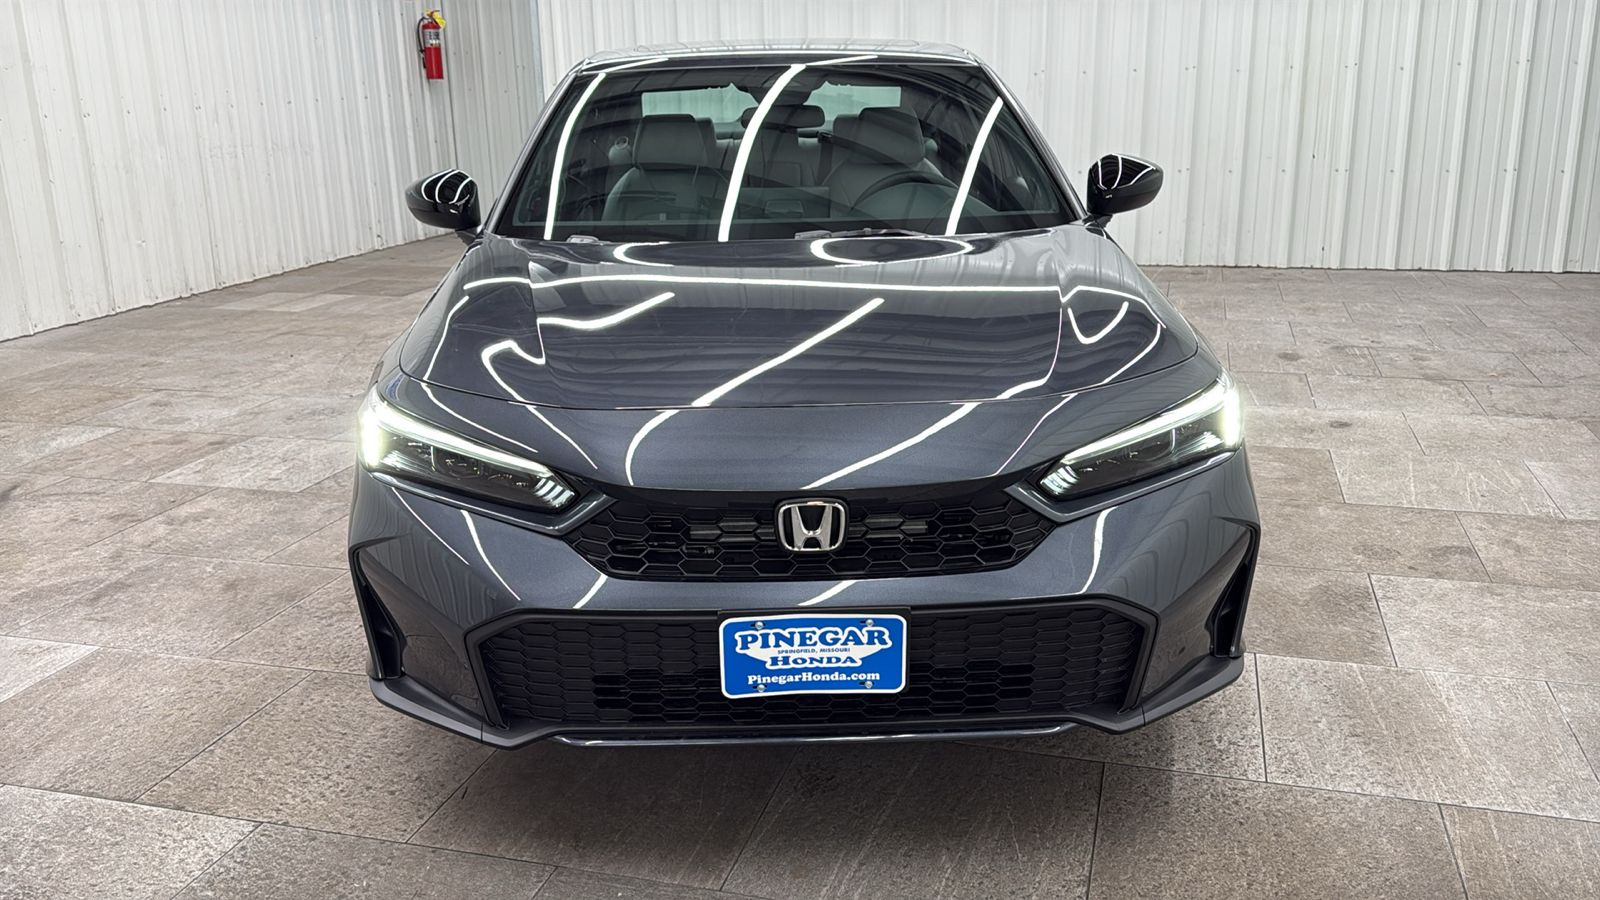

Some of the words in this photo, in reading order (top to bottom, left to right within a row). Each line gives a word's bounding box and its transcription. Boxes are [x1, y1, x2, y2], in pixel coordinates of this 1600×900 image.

[738, 629, 889, 651] PINEGAR
[768, 656, 858, 667] HONDA
[747, 672, 881, 685] PinegarHonda.com
